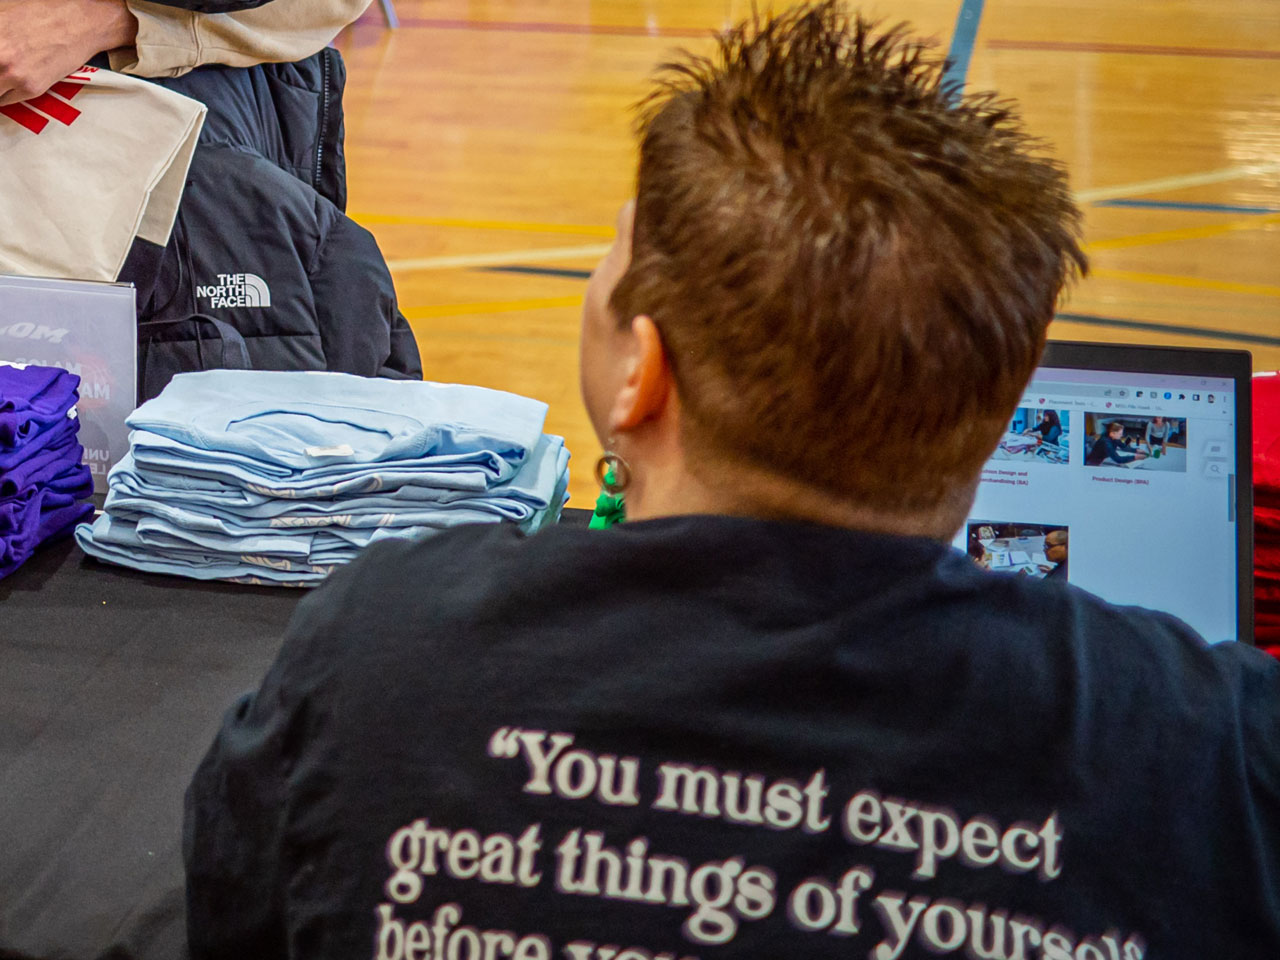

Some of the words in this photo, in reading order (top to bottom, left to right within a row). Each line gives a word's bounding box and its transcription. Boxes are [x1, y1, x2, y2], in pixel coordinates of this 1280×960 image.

[217, 273, 245, 286] THE
[196, 285, 245, 298] NORTH
[211, 295, 246, 308] FACE
[655, 768, 834, 834] must
[845, 790, 1063, 880] expect
[385, 817, 544, 904] great
[556, 828, 777, 944] things
[789, 864, 874, 936] of
